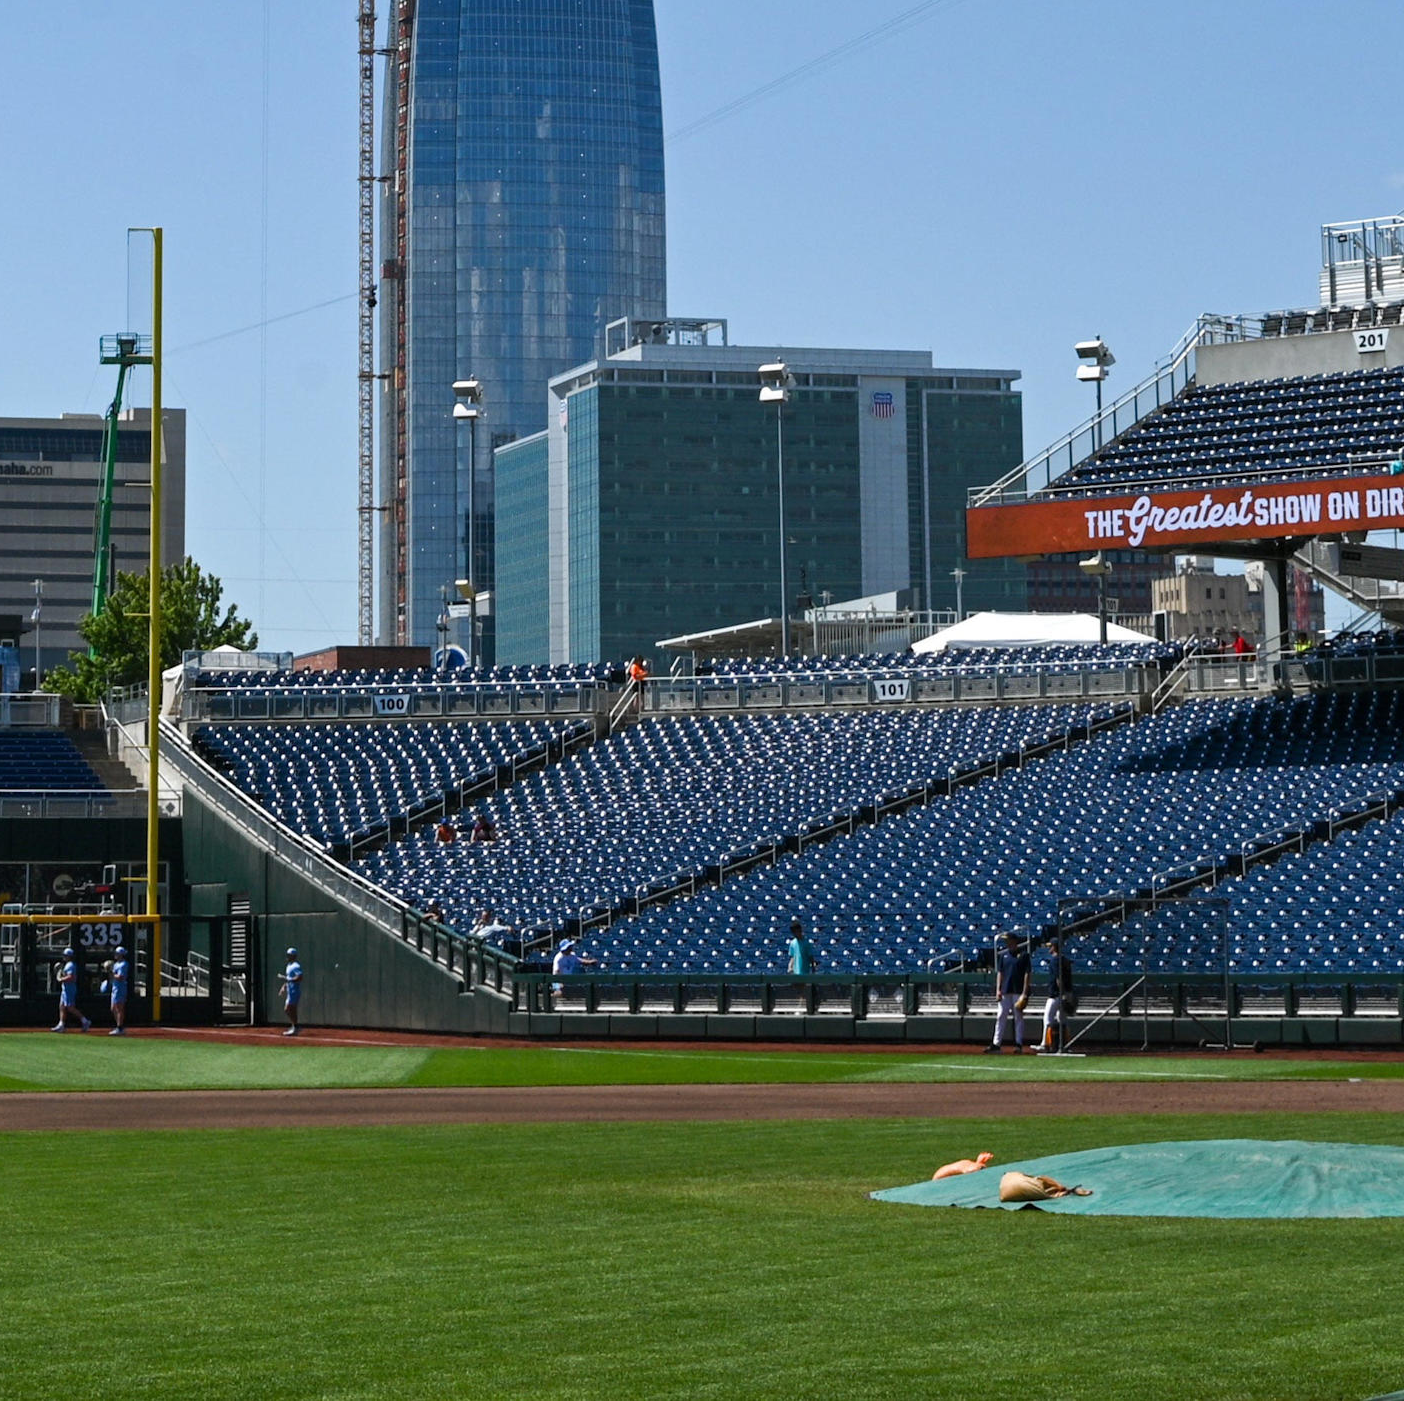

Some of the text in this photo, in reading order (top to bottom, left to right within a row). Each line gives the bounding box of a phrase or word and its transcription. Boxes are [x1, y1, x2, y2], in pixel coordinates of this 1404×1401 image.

[1357, 332, 1385, 349] 201
[1084, 508, 1125, 538] THE
[1124, 490, 1254, 547] Greatest
[1253, 494, 1322, 526] SHOW
[1327, 491, 1360, 520] ON
[879, 683, 905, 699] 101
[378, 696, 405, 712] 100
[79, 923, 123, 946] 335
